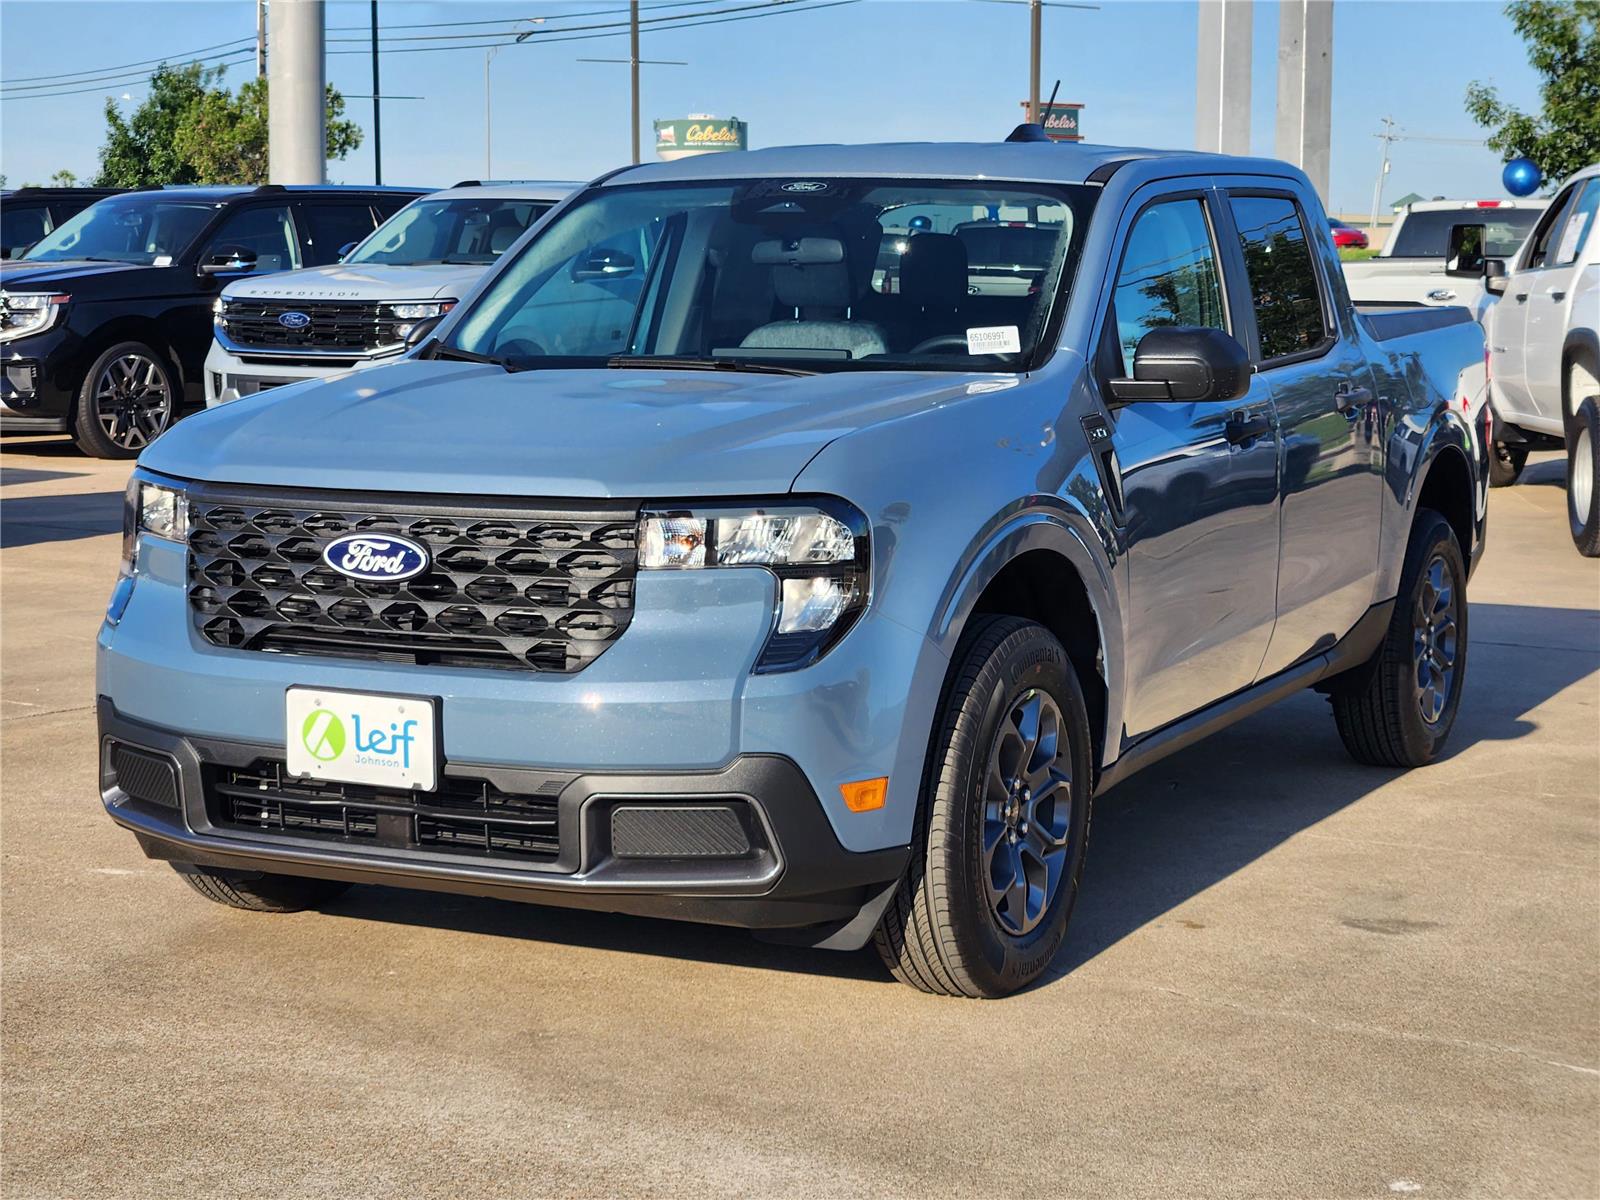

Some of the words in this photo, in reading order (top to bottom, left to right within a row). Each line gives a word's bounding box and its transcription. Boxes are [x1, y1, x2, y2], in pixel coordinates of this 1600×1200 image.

[342, 540, 406, 574] Ford
[352, 714, 417, 768] leif
[355, 754, 399, 768] Johnson
